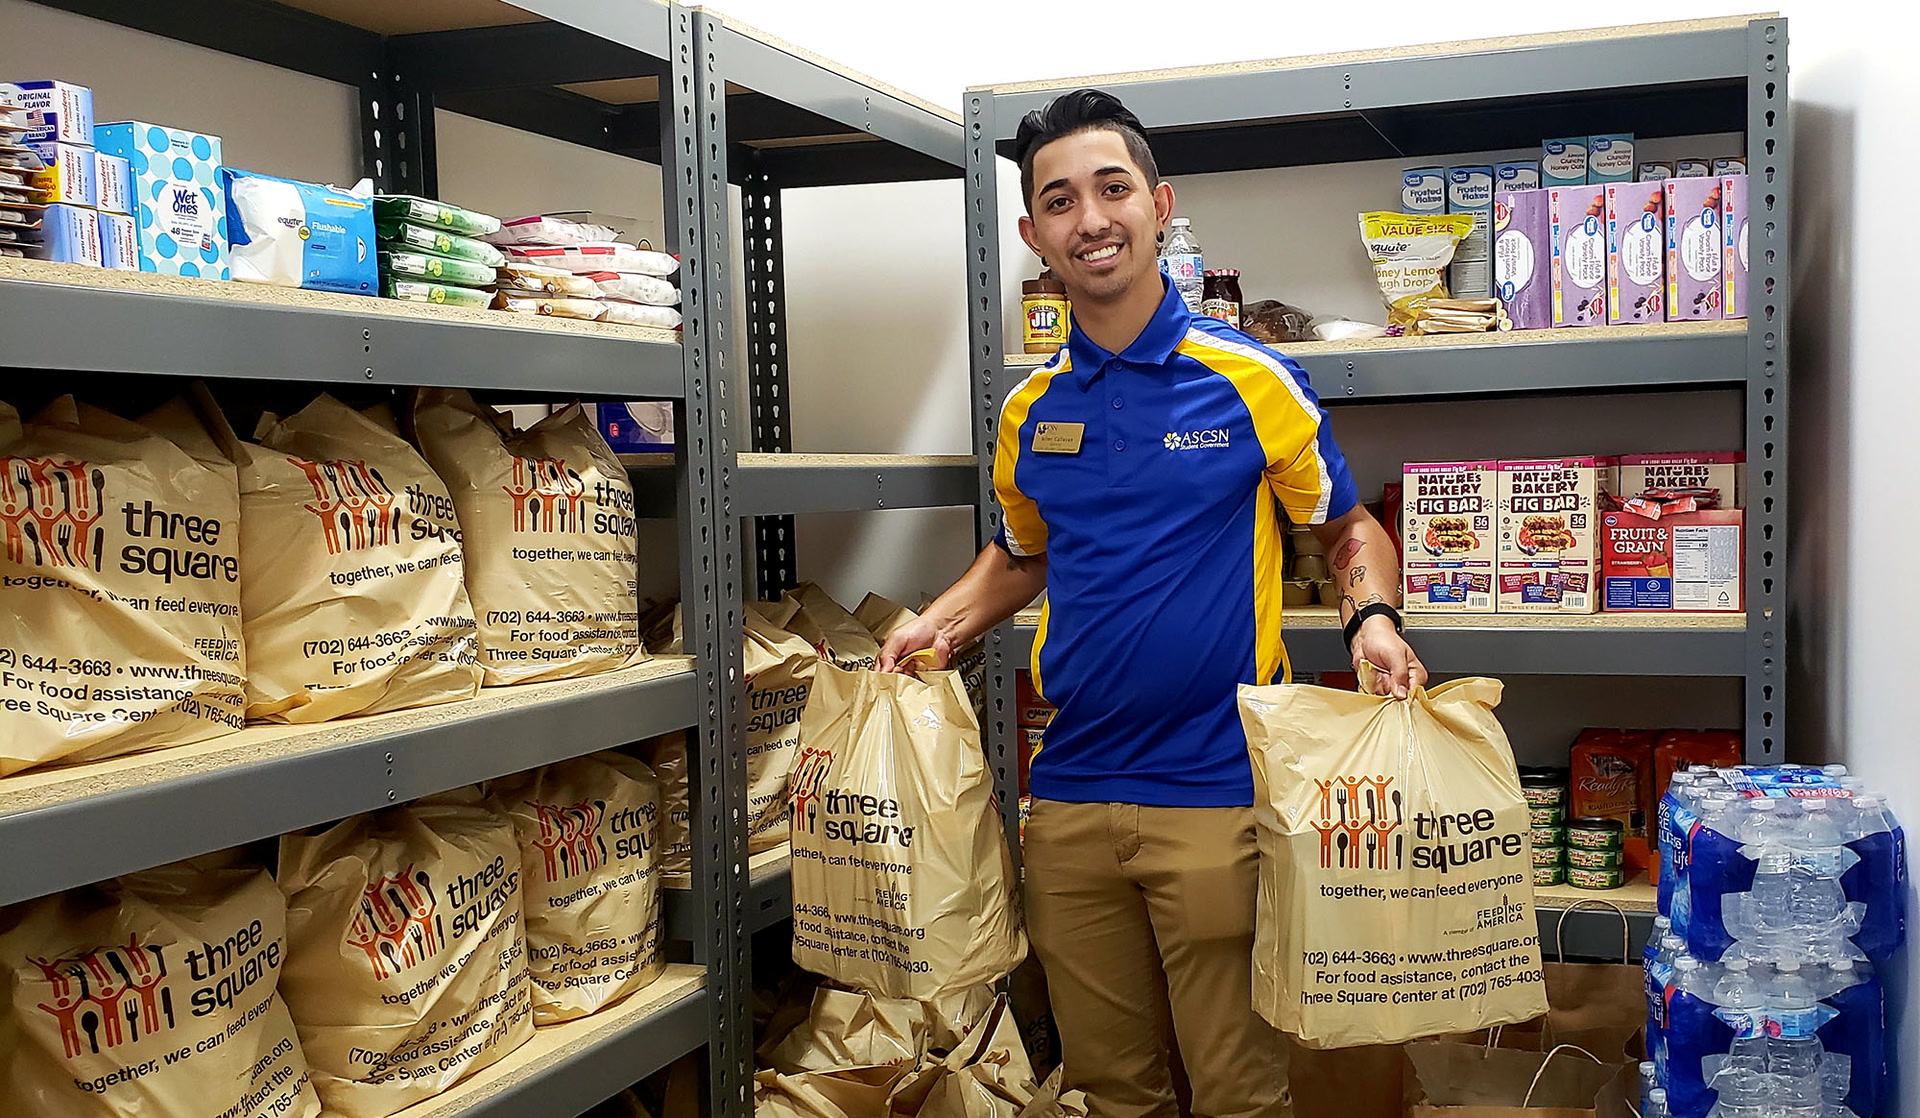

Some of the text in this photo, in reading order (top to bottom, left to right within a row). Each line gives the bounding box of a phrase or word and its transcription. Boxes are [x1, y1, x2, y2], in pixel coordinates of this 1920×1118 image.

[17, 92, 51, 101] ORIGINAL
[24, 101, 51, 109] FLAVOR
[61, 88, 70, 138] Pepsodent
[65, 150, 73, 200] Pepsodent
[100, 159, 109, 207] Pepsodent
[1410, 188, 1442, 197] Frosted
[1456, 185, 1489, 193] Frosted
[1504, 181, 1537, 190] Frosted
[173, 189, 198, 204] Wet
[172, 201, 198, 215] Ones
[170, 227, 181, 235] 48
[311, 221, 346, 234] Flushable
[1381, 224, 1454, 236] VALUE SIZE
[88, 213, 98, 262] Pepsodent
[1181, 429, 1229, 447] ASCSN
[1418, 483, 1482, 496] BAKERY
[1512, 481, 1578, 494] BAKERY
[1644, 476, 1709, 488] BAKERY
[405, 483, 455, 521] three
[1420, 498, 1479, 513] FIG BAR
[1514, 495, 1576, 511] FIG BAR
[121, 500, 221, 546] three
[1475, 516, 1488, 527] 36
[1572, 514, 1585, 525] 36
[1609, 528, 1669, 541] FRUIT &
[512, 547, 574, 563] together,
[577, 550, 592, 561] we
[593, 550, 611, 561] can
[1613, 541, 1665, 554] GRAIN
[119, 545, 239, 584] square
[329, 557, 438, 587] together, we can
[155, 595, 186, 613] feed
[486, 610, 585, 627] (702) 644-3663
[303, 628, 412, 659] (702) 644-3663
[510, 628, 569, 642] For food
[486, 644, 577, 662] Three Square
[22, 654, 112, 677] 644-3663
[332, 652, 396, 676] For food
[3, 670, 35, 692] For
[39, 681, 89, 701] food
[750, 683, 808, 711] three
[763, 738, 783, 753] feed
[1579, 775, 1620, 797] Ready
[825, 788, 899, 819] three
[825, 819, 914, 847] square
[1412, 832, 1523, 874] square
[828, 854, 912, 875] can everyone
[446, 855, 505, 910] three
[548, 873, 635, 908] together, we can
[1320, 873, 1524, 901] together, we can feed everyone
[1477, 902, 1523, 920] FEEDING
[800, 918, 822, 934] food
[1476, 912, 1524, 931] AMERICA
[184, 918, 263, 983] three
[1332, 950, 1396, 966] 644-3663
[568, 955, 597, 972] food
[1316, 954, 1530, 986] For food assistance, contact the
[190, 941, 282, 1018] square
[381, 962, 458, 1006] together, we
[564, 971, 611, 989] Square
[1336, 982, 1487, 1007] Square Center at (702)
[74, 1011, 247, 1094] together, we can feed
[438, 1041, 484, 1071] Center
[273, 1064, 294, 1088] the
